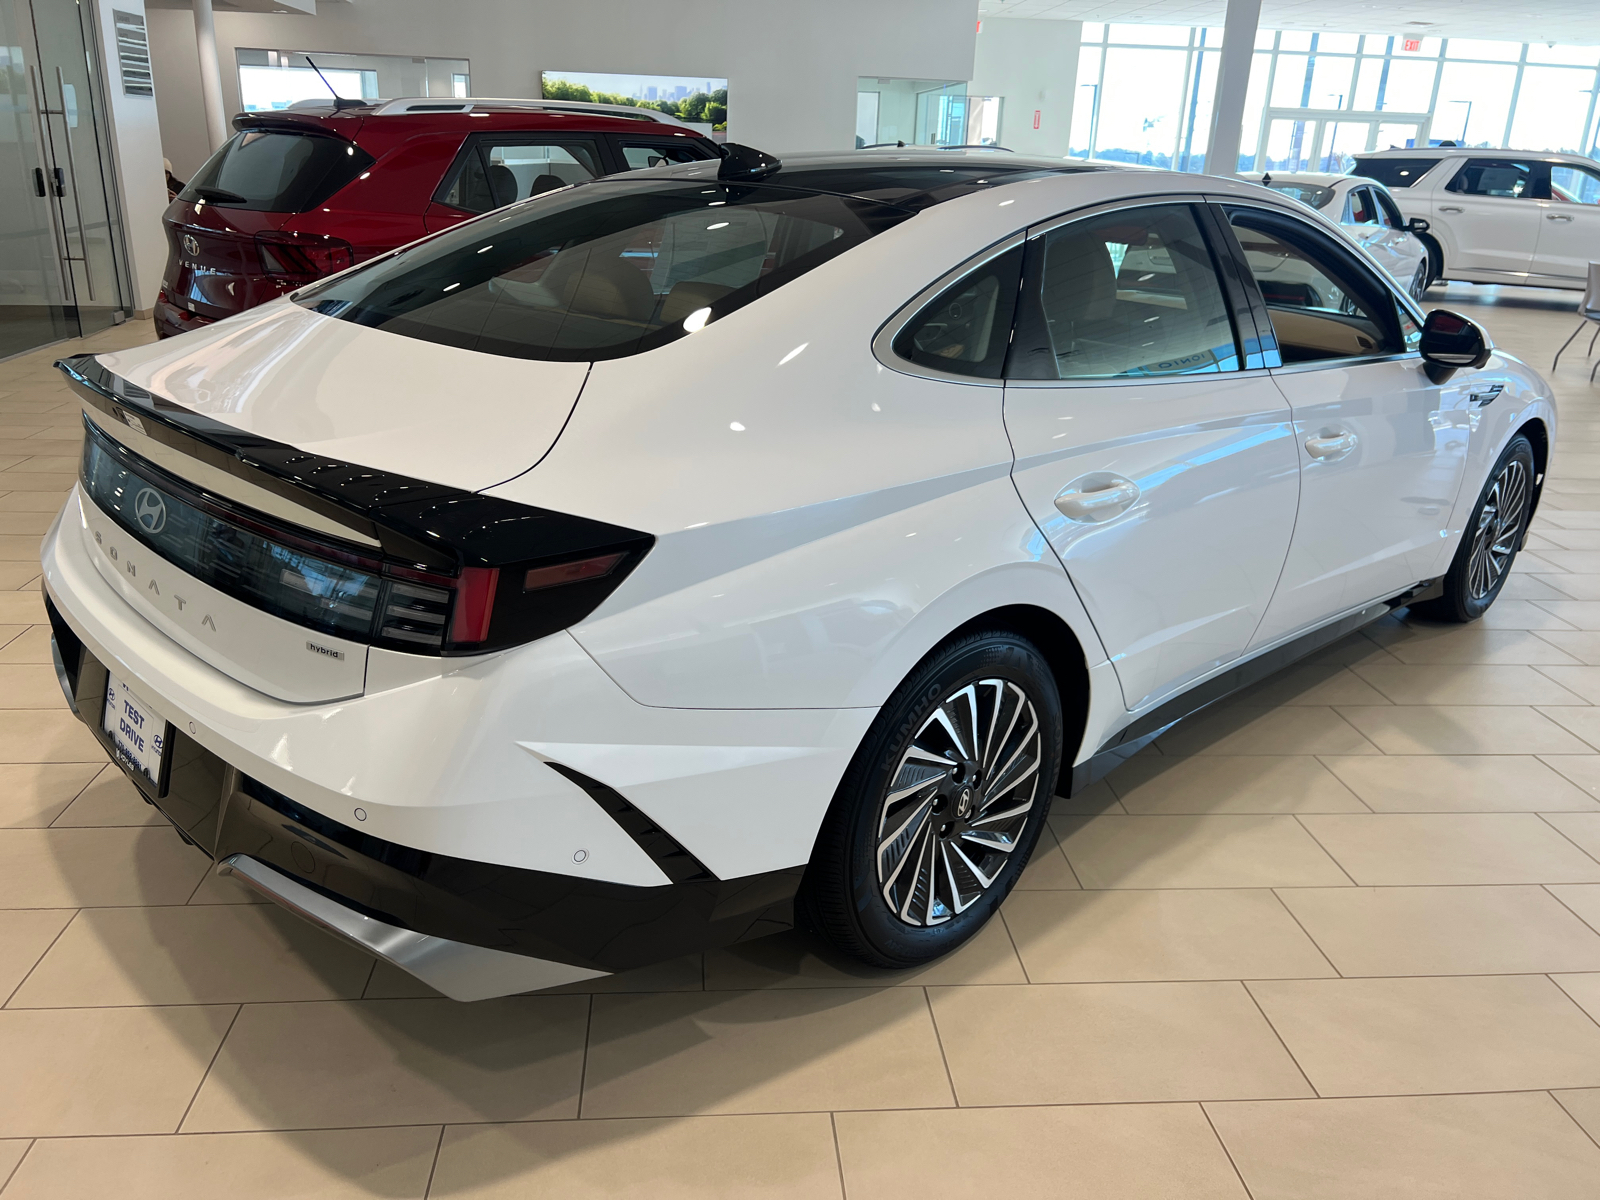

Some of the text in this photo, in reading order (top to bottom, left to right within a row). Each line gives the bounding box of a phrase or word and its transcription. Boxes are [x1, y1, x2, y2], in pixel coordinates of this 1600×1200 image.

[1404, 40, 1420, 51] EXIT
[179, 259, 216, 275] VENUE
[95, 531, 217, 632] SONATA
[310, 643, 339, 658] hybrid
[124, 700, 145, 729] TEST
[881, 683, 942, 771] KUMHO
[119, 717, 145, 753] DRIVE
